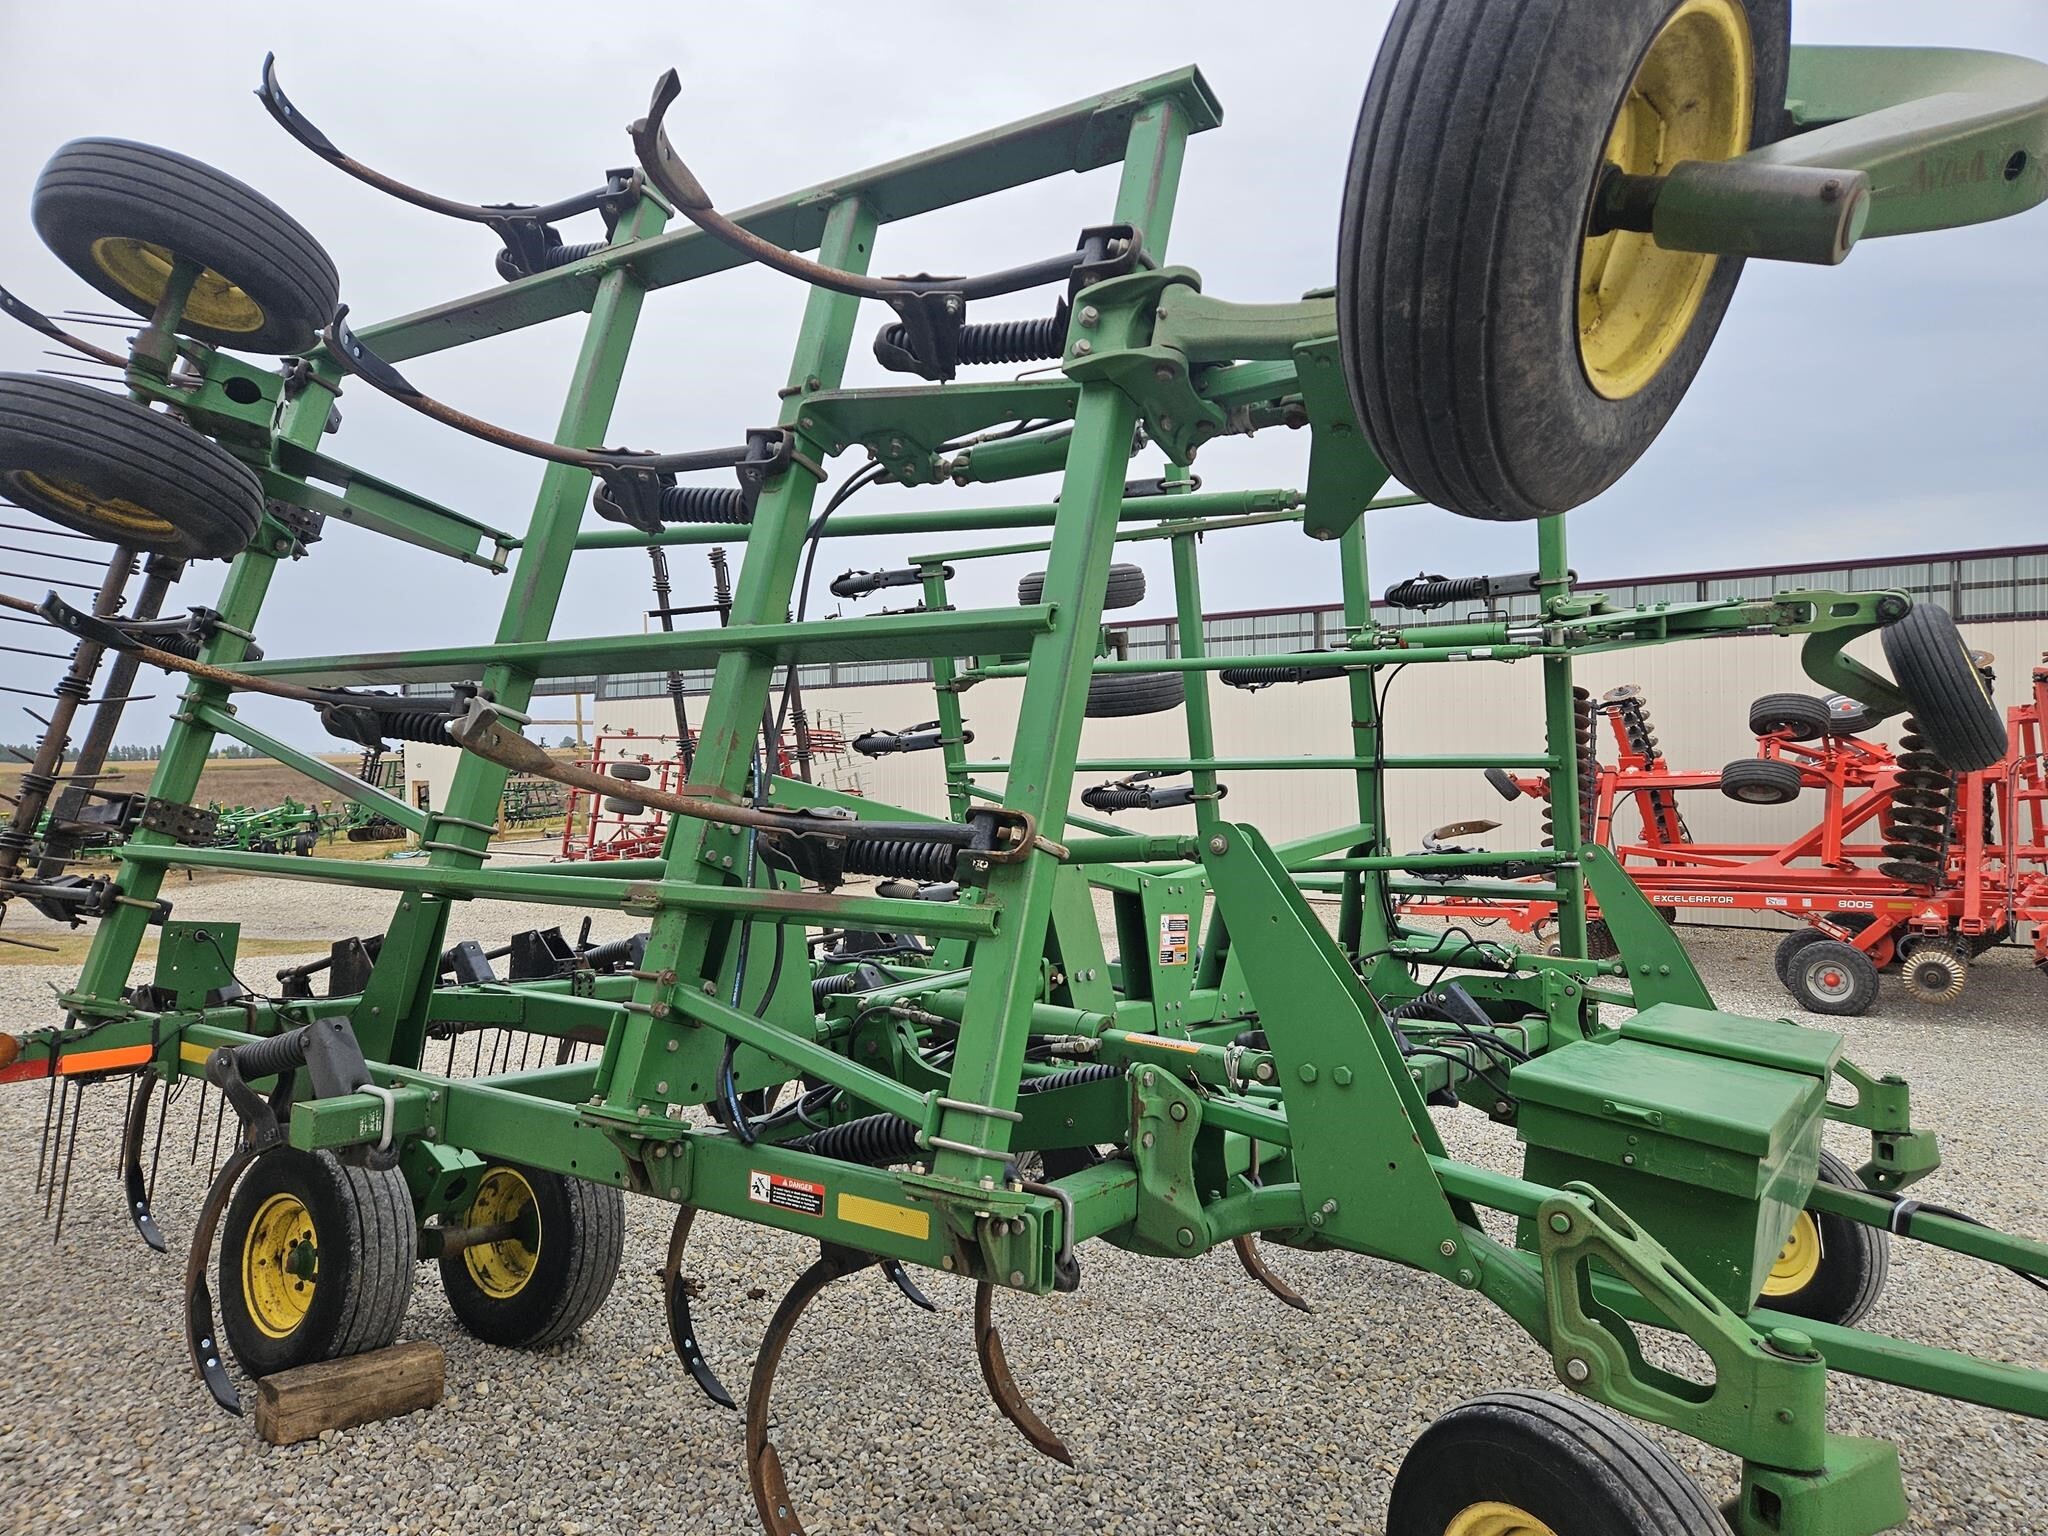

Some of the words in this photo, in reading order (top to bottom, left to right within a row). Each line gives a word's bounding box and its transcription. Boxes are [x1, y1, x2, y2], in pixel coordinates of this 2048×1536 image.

[1653, 895, 1734, 904] EXCELERATOR
[1838, 900, 1874, 909] 8005
[788, 1180, 813, 1191] DANGER
